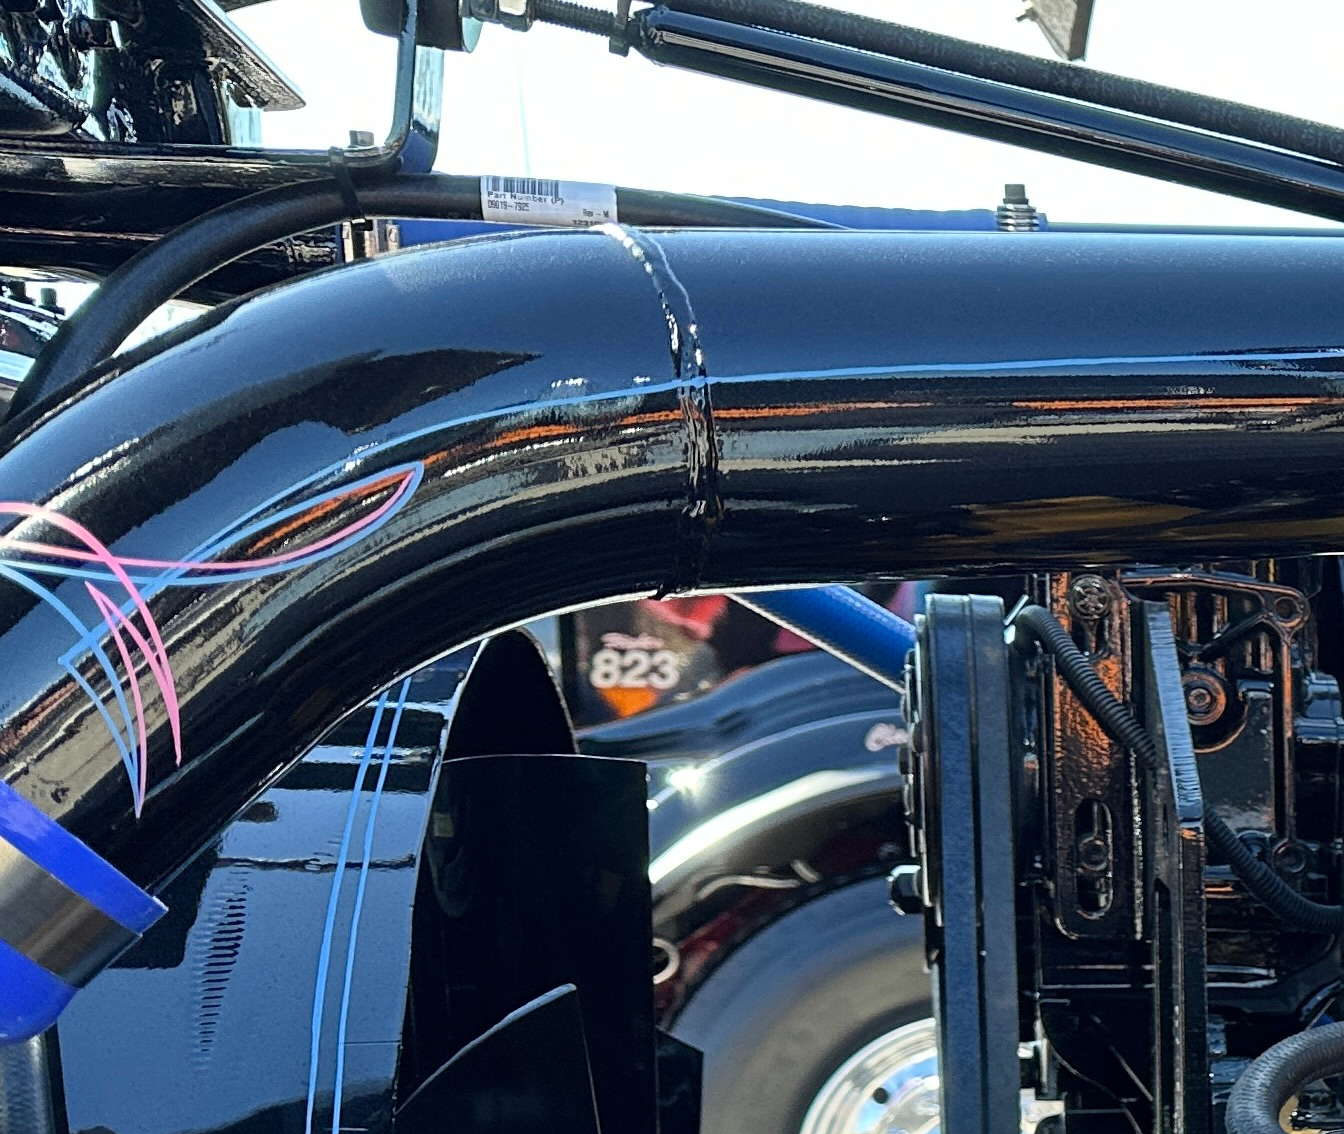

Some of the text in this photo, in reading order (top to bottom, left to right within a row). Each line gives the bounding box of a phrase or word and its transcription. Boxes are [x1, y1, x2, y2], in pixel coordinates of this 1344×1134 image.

[487, 190, 506, 200] Part
[510, 192, 548, 203] Number
[589, 649, 681, 690] 823
